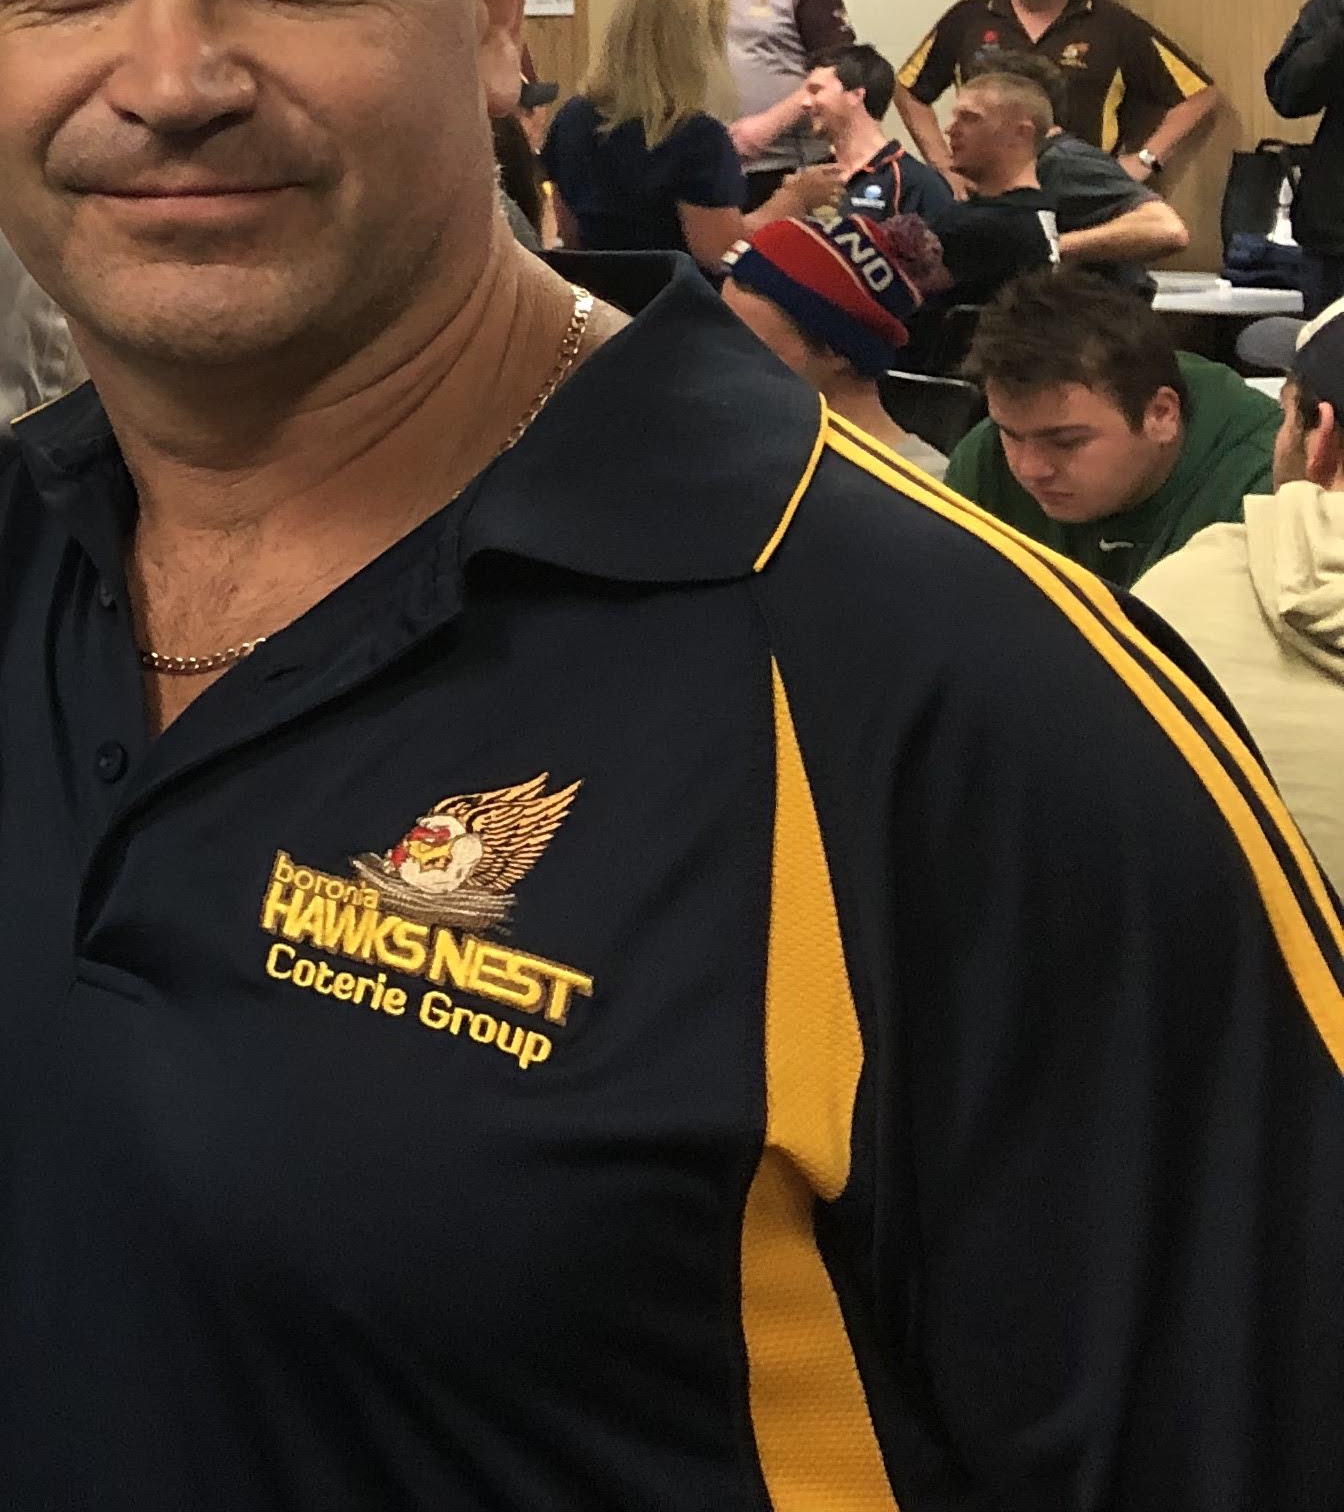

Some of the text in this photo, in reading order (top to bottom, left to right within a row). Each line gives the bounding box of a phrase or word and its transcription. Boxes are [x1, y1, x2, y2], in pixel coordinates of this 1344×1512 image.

[274, 854, 380, 909] boronia
[265, 943, 553, 1069] Coterie Group
